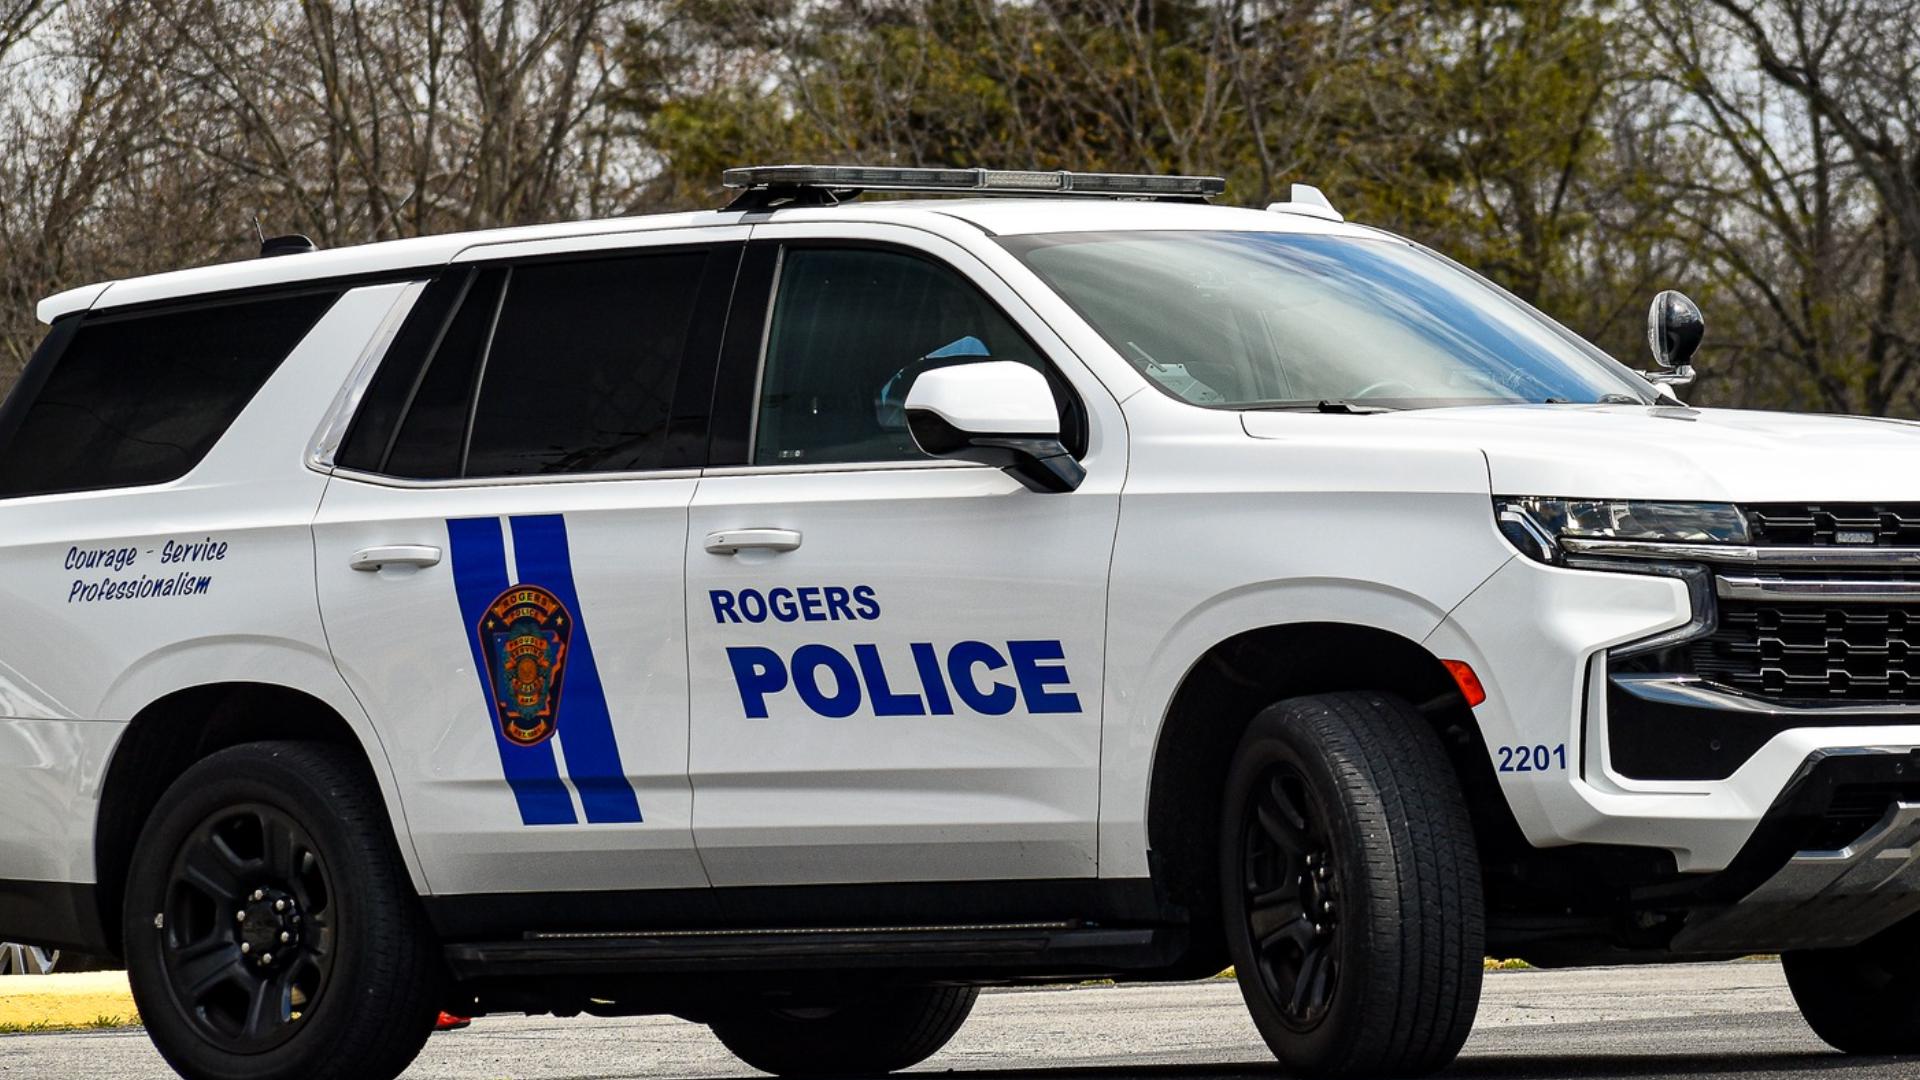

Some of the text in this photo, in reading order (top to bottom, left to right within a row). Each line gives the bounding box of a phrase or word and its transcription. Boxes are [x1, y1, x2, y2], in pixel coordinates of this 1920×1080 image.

[65, 546, 137, 571] Courage
[161, 537, 228, 564] Service
[68, 572, 212, 603] Professionalism
[503, 592, 547, 608] ROGERS
[510, 608, 540, 619] POLICE
[709, 585, 881, 624] ROGERS
[509, 637, 544, 649] PROUDLY
[726, 640, 1083, 719] POLICE
[1498, 743, 1567, 773] 2201
